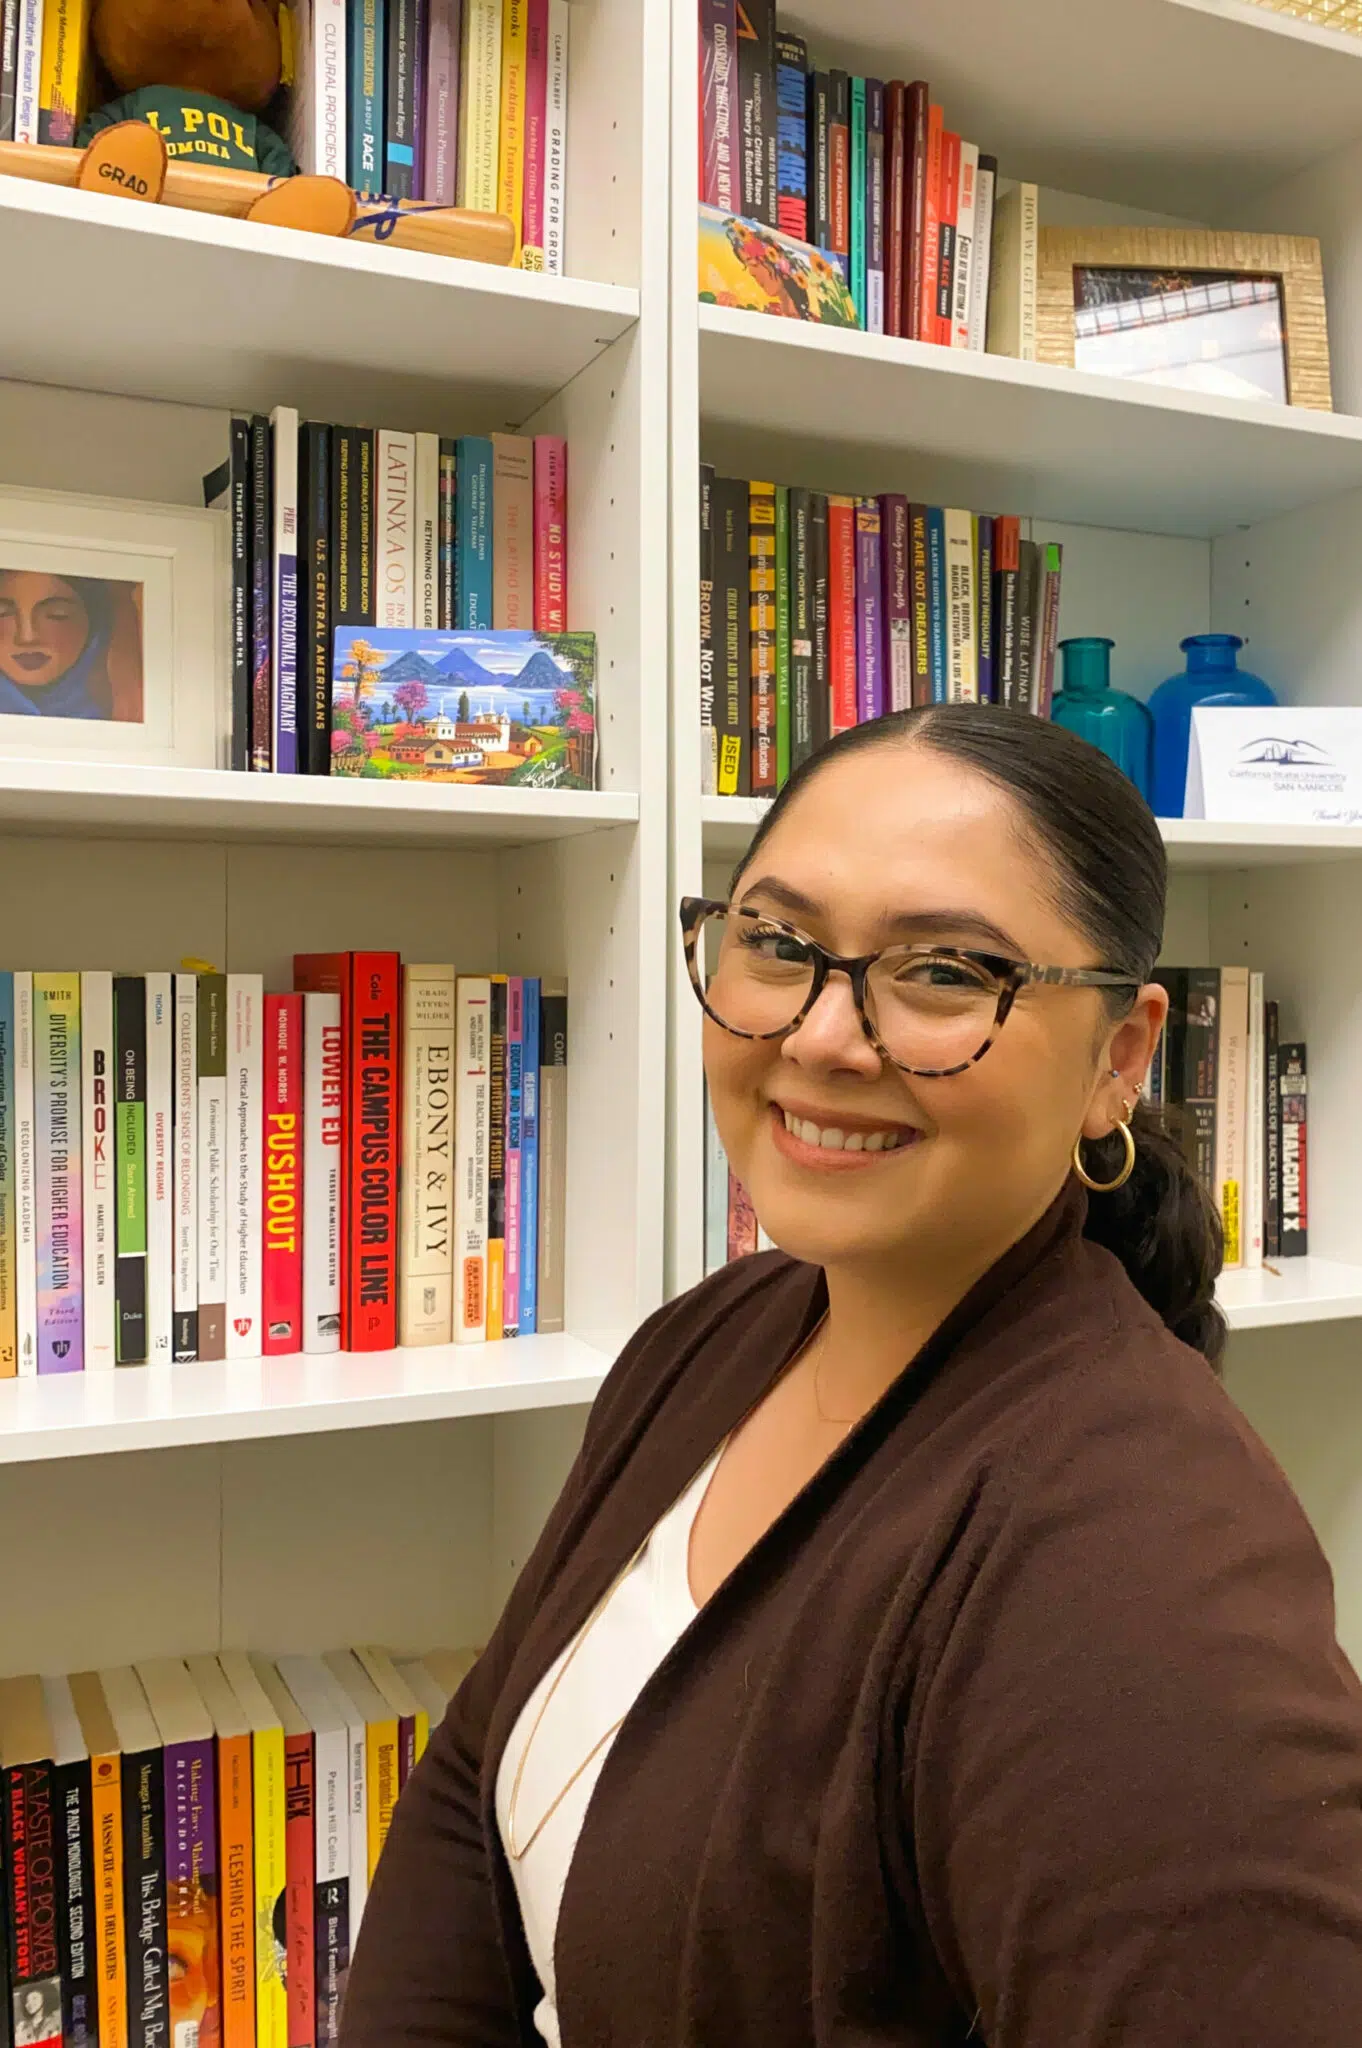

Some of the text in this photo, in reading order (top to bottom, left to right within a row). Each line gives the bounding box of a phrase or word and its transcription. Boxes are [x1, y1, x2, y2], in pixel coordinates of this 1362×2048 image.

[24, 50, 37, 92] Research
[20, 96, 36, 127] Design
[165, 139, 232, 160] OMONA
[364, 99, 373, 131] ABOUT
[743, 99, 754, 203] Theory in Education
[754, 73, 763, 205] Handbook of Critical Race
[98, 162, 149, 196] GRAD
[362, 133, 375, 171] RACE
[550, 129, 562, 190] GRADING
[549, 198, 560, 223] FOR
[835, 167, 843, 246] FRAMEWORKS
[1024, 197, 1035, 231] HOW
[255, 426, 265, 468] TOWARD
[255, 470, 265, 499] WHAT
[316, 539, 326, 565] U.S.
[701, 503, 710, 529] Miguel
[424, 520, 433, 629] RETHINKING COLLEGE
[549, 524, 561, 601] NO STUDY
[797, 509, 805, 630] ASIANS IN THE IVORY TOWER
[913, 517, 927, 674] WE ARE NOT DREAMERS
[316, 573, 326, 639] CENTRAL
[816, 578, 825, 680] We ARE Americans
[865, 597, 875, 614] The
[865, 617, 875, 654] Latina/o
[280, 573, 297, 734] THE DECOLONIAL IMAGINARY
[316, 645, 326, 730] AMERICANS
[755, 537, 771, 778] Ensuring the Success of Latino Males in Higher Education
[863, 656, 875, 692] Pathway
[1019, 616, 1030, 703] WISE LATINAS
[865, 695, 874, 704] to
[43, 991, 72, 1001] SMITH
[154, 994, 163, 1025] THOMAS
[181, 1012, 191, 1055] COLLEGE
[277, 1008, 288, 1103] MONIQUE W. MORRIS
[321, 1026, 341, 1146] LOWER ED
[510, 1044, 521, 1091] EDUCATION
[125, 1050, 138, 1219] ON BEING INCLUDED Sara Ahmed
[181, 1111, 191, 1139] SENSE
[509, 1116, 520, 1149] RACISM
[510, 1095, 520, 1112] AND
[21, 1121, 31, 1243] DECOLONIZING ACADEMIA
[50, 1014, 69, 1290] DIVERSITY'S PROMISE FOR HIGHER EDUCATION
[155, 1112, 164, 1201] DIVERSITY REGIMES
[181, 1142, 191, 1155] OF
[181, 1158, 191, 1216] BELONGING
[236, 1068, 249, 1294] Critical Approaches to the Study of Higher Education
[266, 1113, 295, 1253] PUSHOUT
[360, 1012, 390, 1306] THE CAMPUS COLOR LINE
[426, 1045, 449, 1256] EBONY & IVY
[1282, 1123, 1300, 1232] MALCOLM X
[207, 1099, 219, 1282] Envisioning Public Scholarship for Our Time
[96, 1204, 105, 1286] HAMILTON NIELSEN
[123, 1312, 143, 1321] Duke
[177, 1760, 188, 1918] HACIENDO CARAS
[327, 1771, 337, 1874] Patricia Hill Collins
[11, 1772, 29, 1977] A BLACK WOMAN'S STORY
[28, 1768, 56, 1976] A TASTE OF POWER
[66, 1788, 86, 1979] THE PANZA MONOLOGUES, SECOND EDITION
[228, 1844, 246, 2004] FLESHING THE SPIRIT
[326, 1917, 338, 2039] Black Feminist Thought
